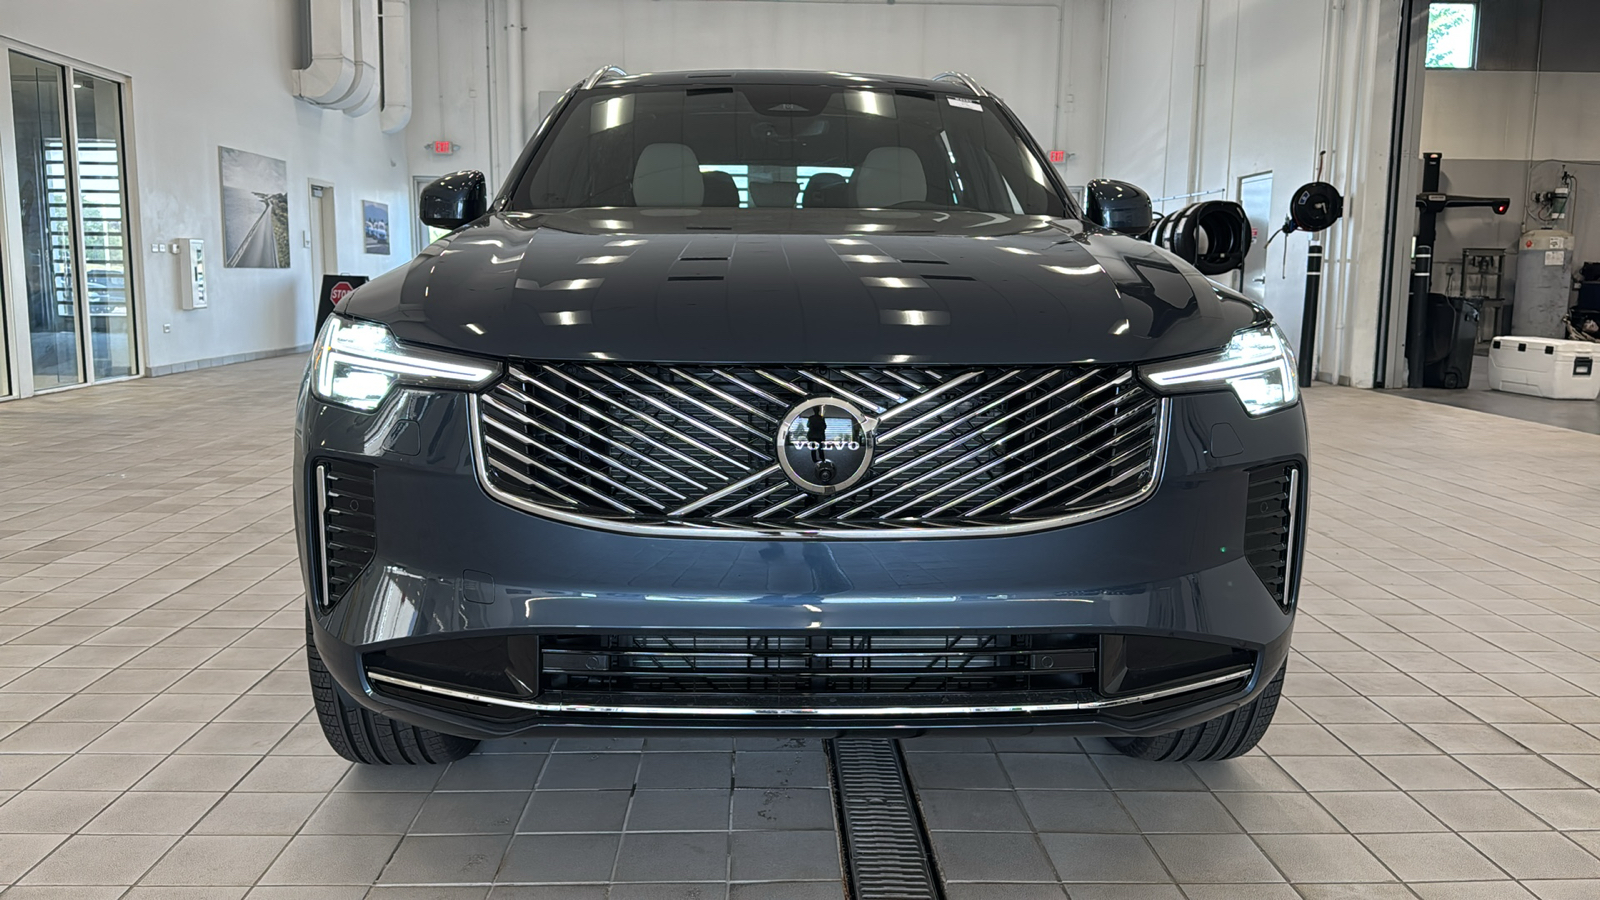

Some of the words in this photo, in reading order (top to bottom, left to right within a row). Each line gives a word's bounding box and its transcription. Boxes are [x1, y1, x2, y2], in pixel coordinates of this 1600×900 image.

[435, 141, 449, 153] EXIT
[1050, 151, 1064, 162] EXIT
[332, 289, 351, 299] STO
[791, 441, 860, 450] VOLVO
